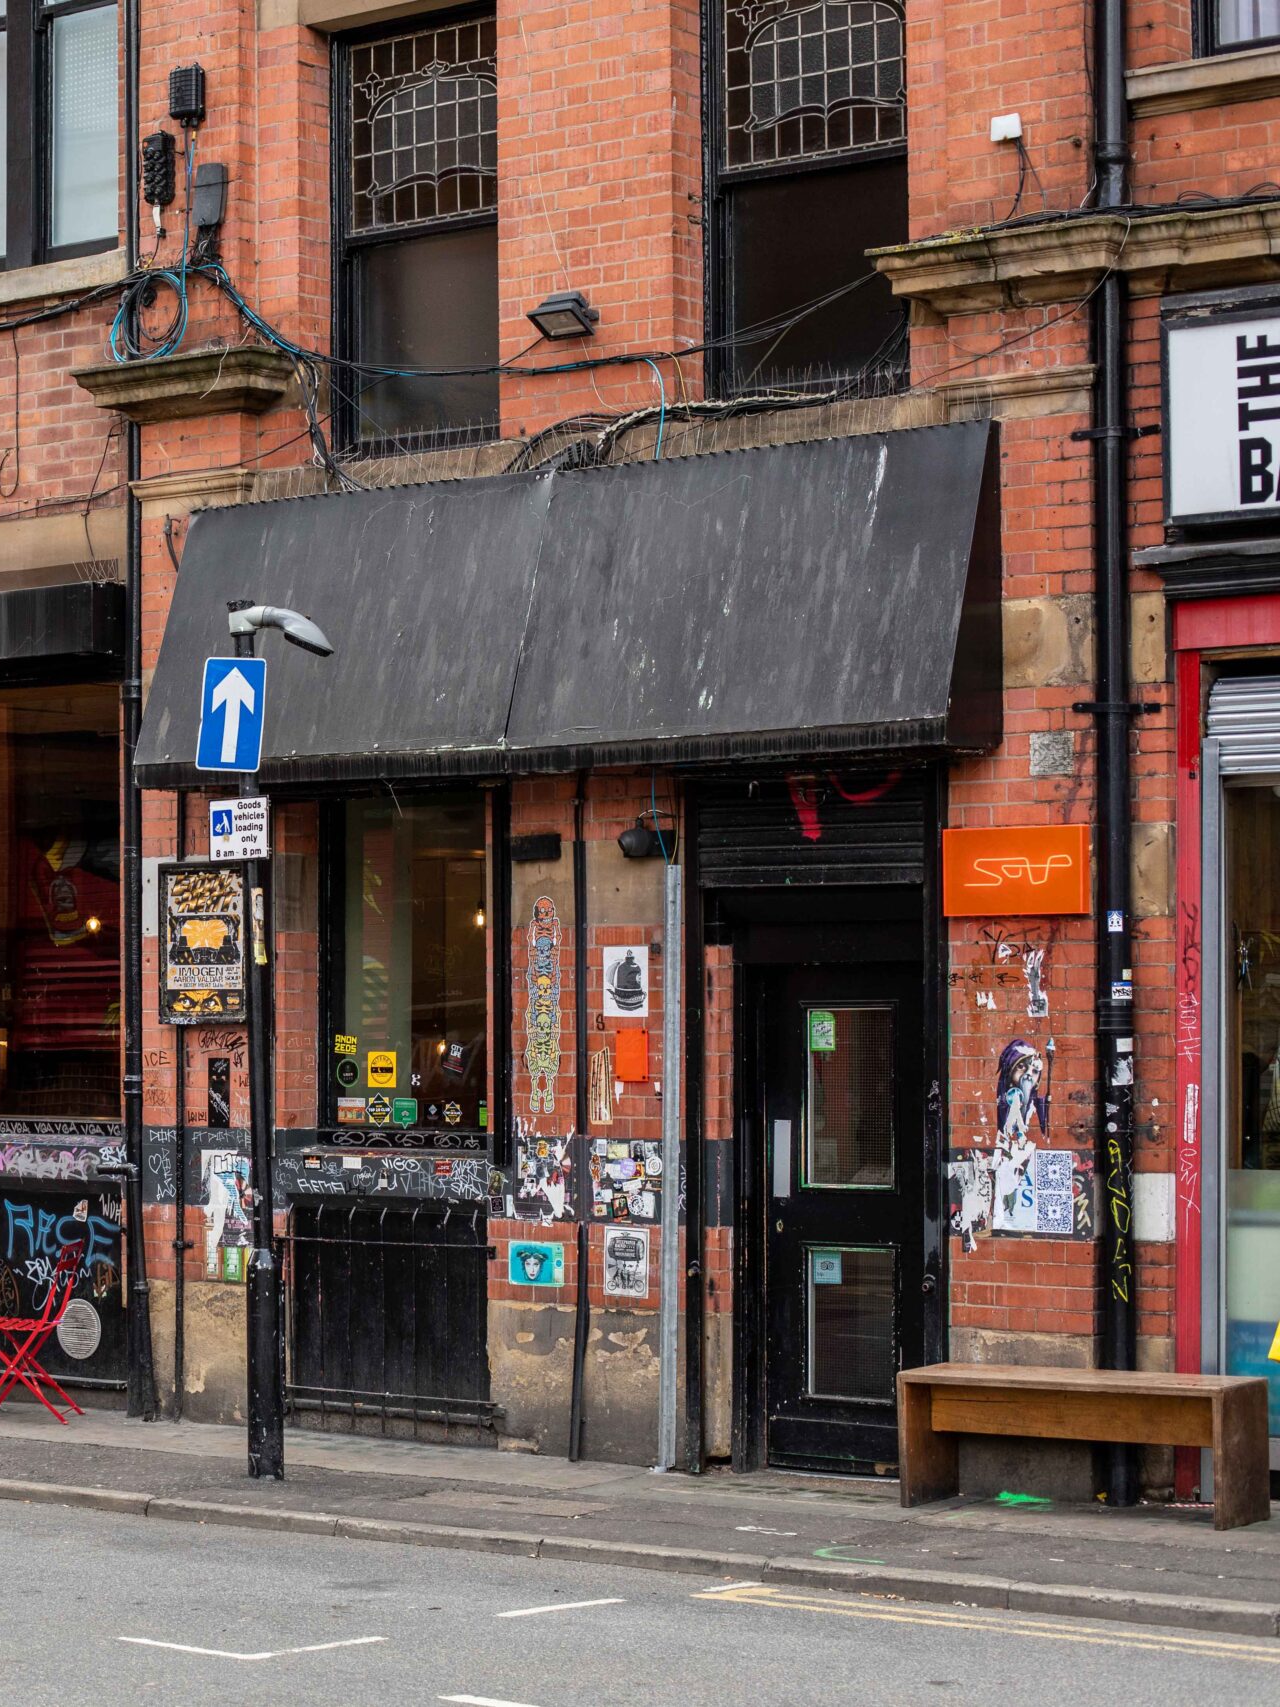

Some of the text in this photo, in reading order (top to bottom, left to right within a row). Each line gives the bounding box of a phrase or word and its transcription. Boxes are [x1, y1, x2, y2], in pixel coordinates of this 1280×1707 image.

[237, 801, 261, 810] Goods
[234, 811, 265, 821] vehicles
[235, 823, 263, 832] loading
[241, 833, 258, 843] only
[215, 849, 221, 858] 8
[242, 847, 248, 856] 8
[250, 848, 262, 856] pm
[178, 967, 224, 976] IMOGEN
